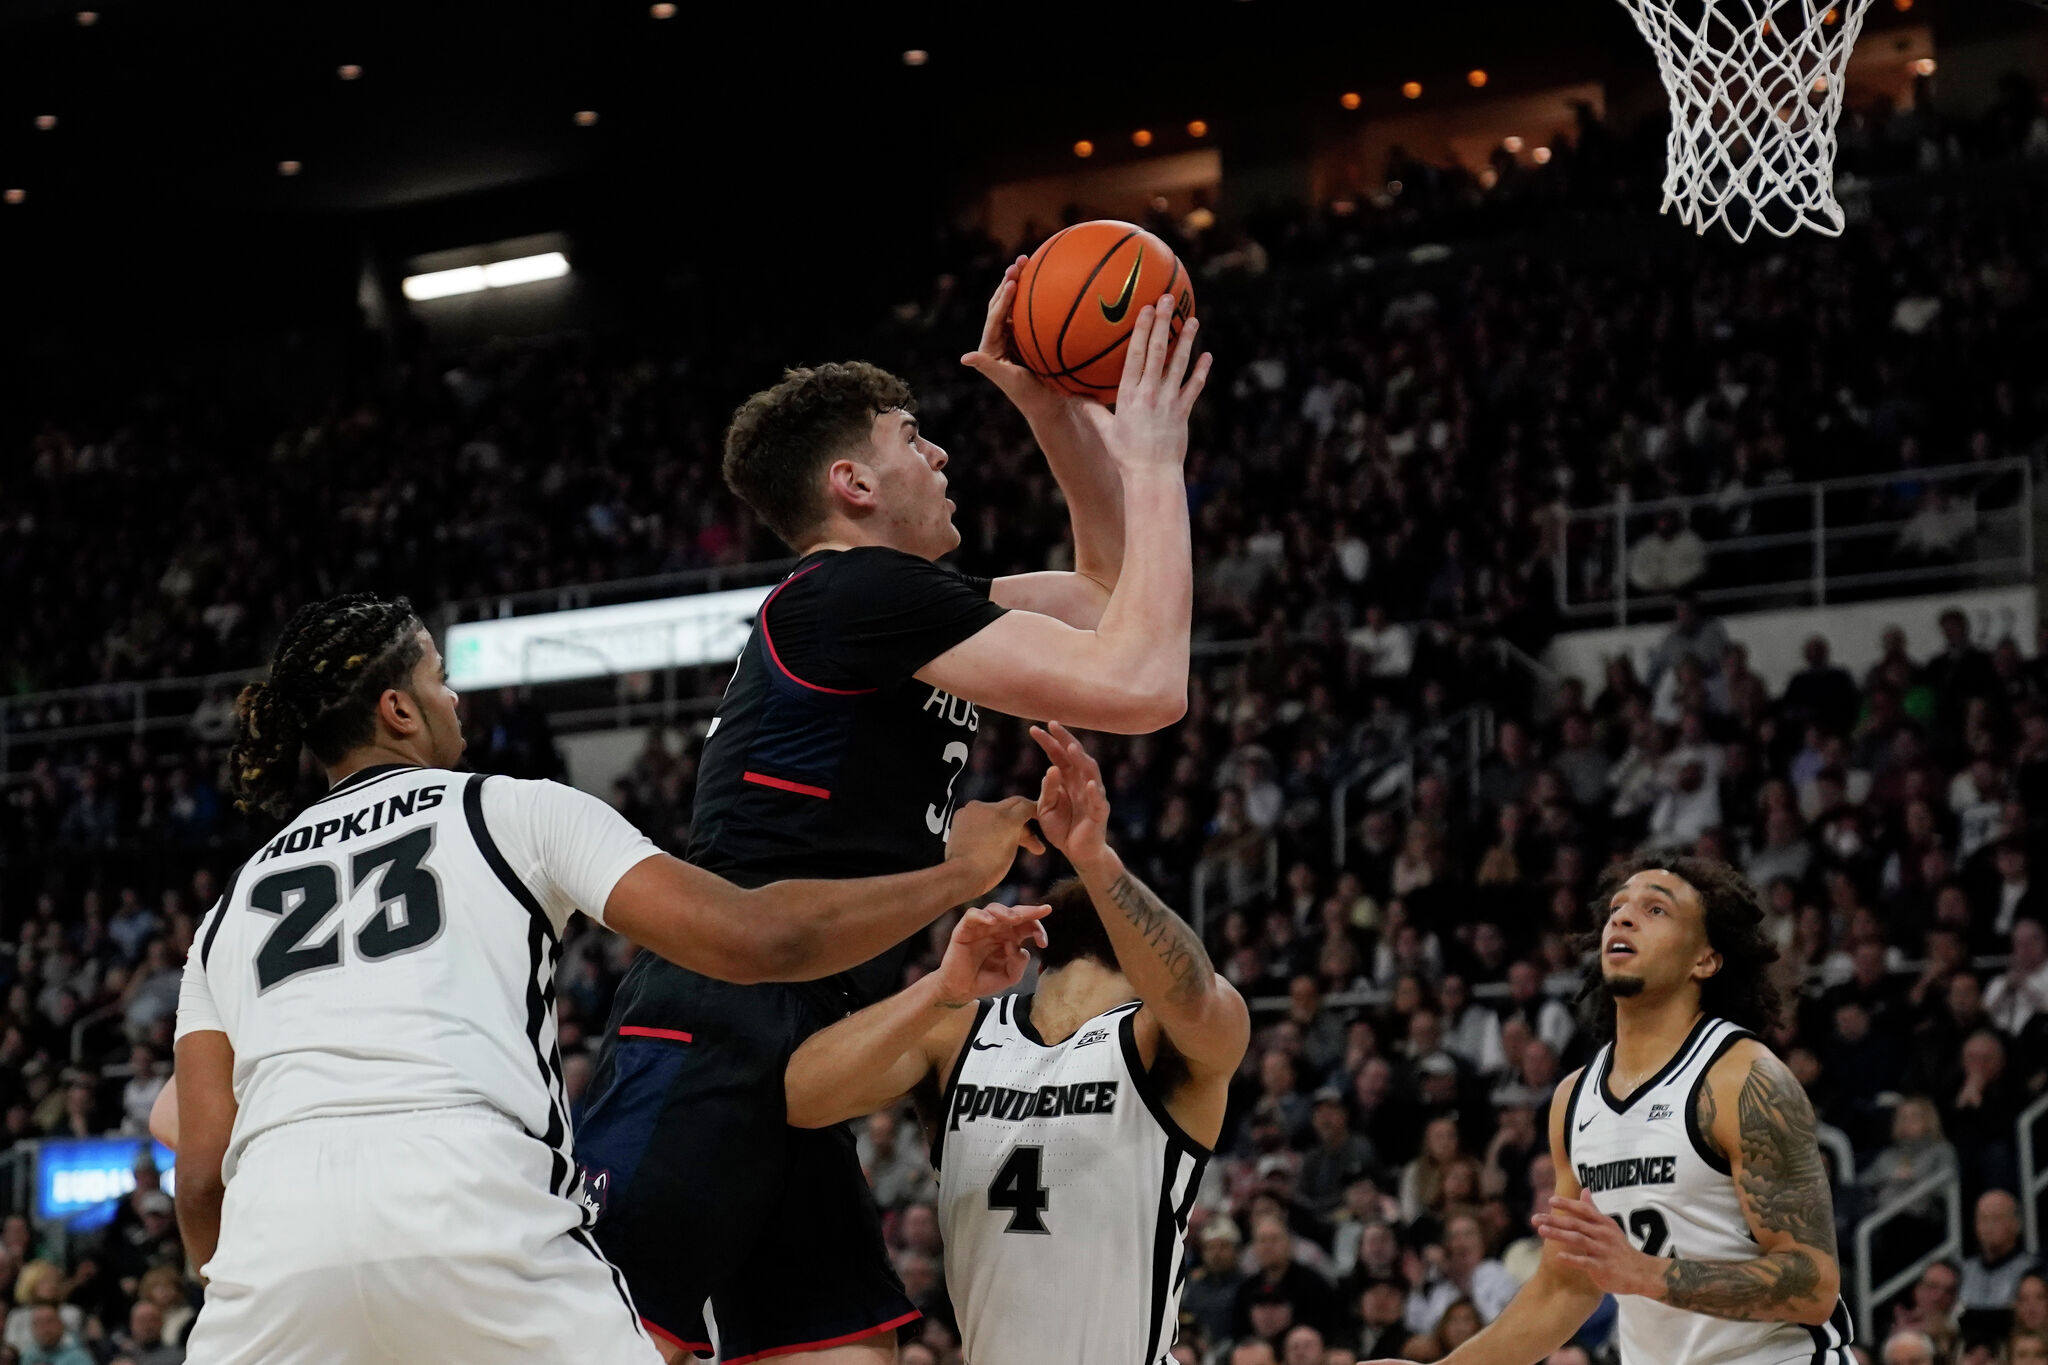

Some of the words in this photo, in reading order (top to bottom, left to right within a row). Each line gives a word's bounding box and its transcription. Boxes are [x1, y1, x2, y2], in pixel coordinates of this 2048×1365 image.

[926, 741, 968, 842] 3
[256, 785, 447, 865] HOPKINS
[246, 822, 447, 998] 23
[1077, 1033, 1110, 1045] EAST
[1648, 1110, 1675, 1118] EAST
[987, 1144, 1051, 1235] 4
[1577, 1155, 1677, 1192] PROVIDENCE
[1610, 1207, 1679, 1258] 2
